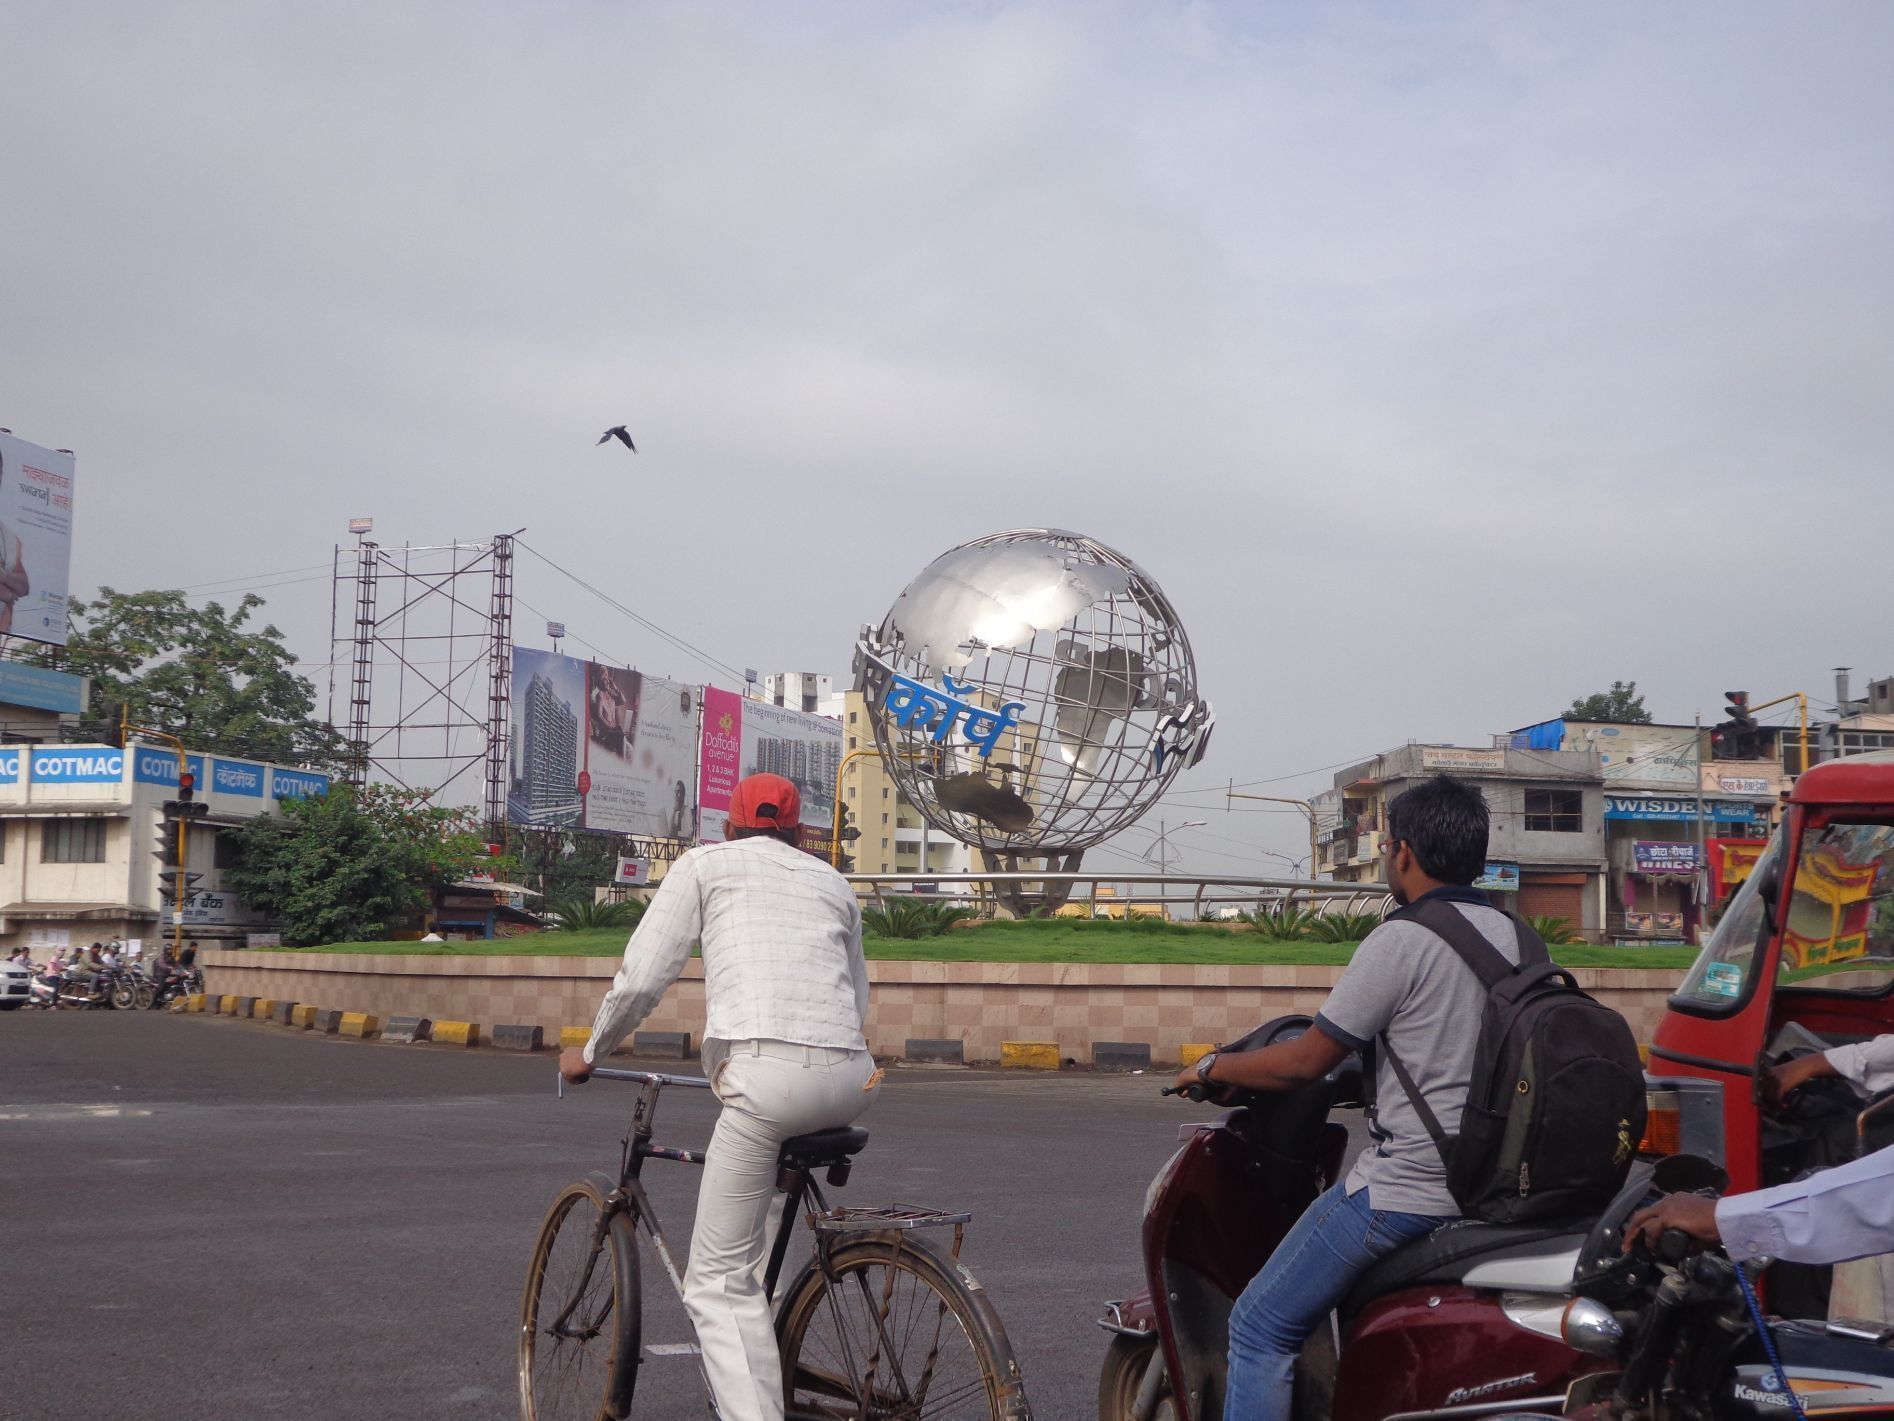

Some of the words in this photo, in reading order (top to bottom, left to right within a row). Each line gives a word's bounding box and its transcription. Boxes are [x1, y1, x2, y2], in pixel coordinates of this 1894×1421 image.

[743, 702, 753, 714] The
[754, 705, 780, 724] beginning
[786, 715, 798, 725] new
[798, 717, 812, 732] living
[705, 731, 739, 753] Daffodils
[708, 748, 735, 762] avenue
[34, 756, 122, 776] COTMAC
[1615, 800, 1714, 814] WISDEN
[1717, 801, 1755, 809] SPORTS
[1720, 808, 1750, 816] WEAR
